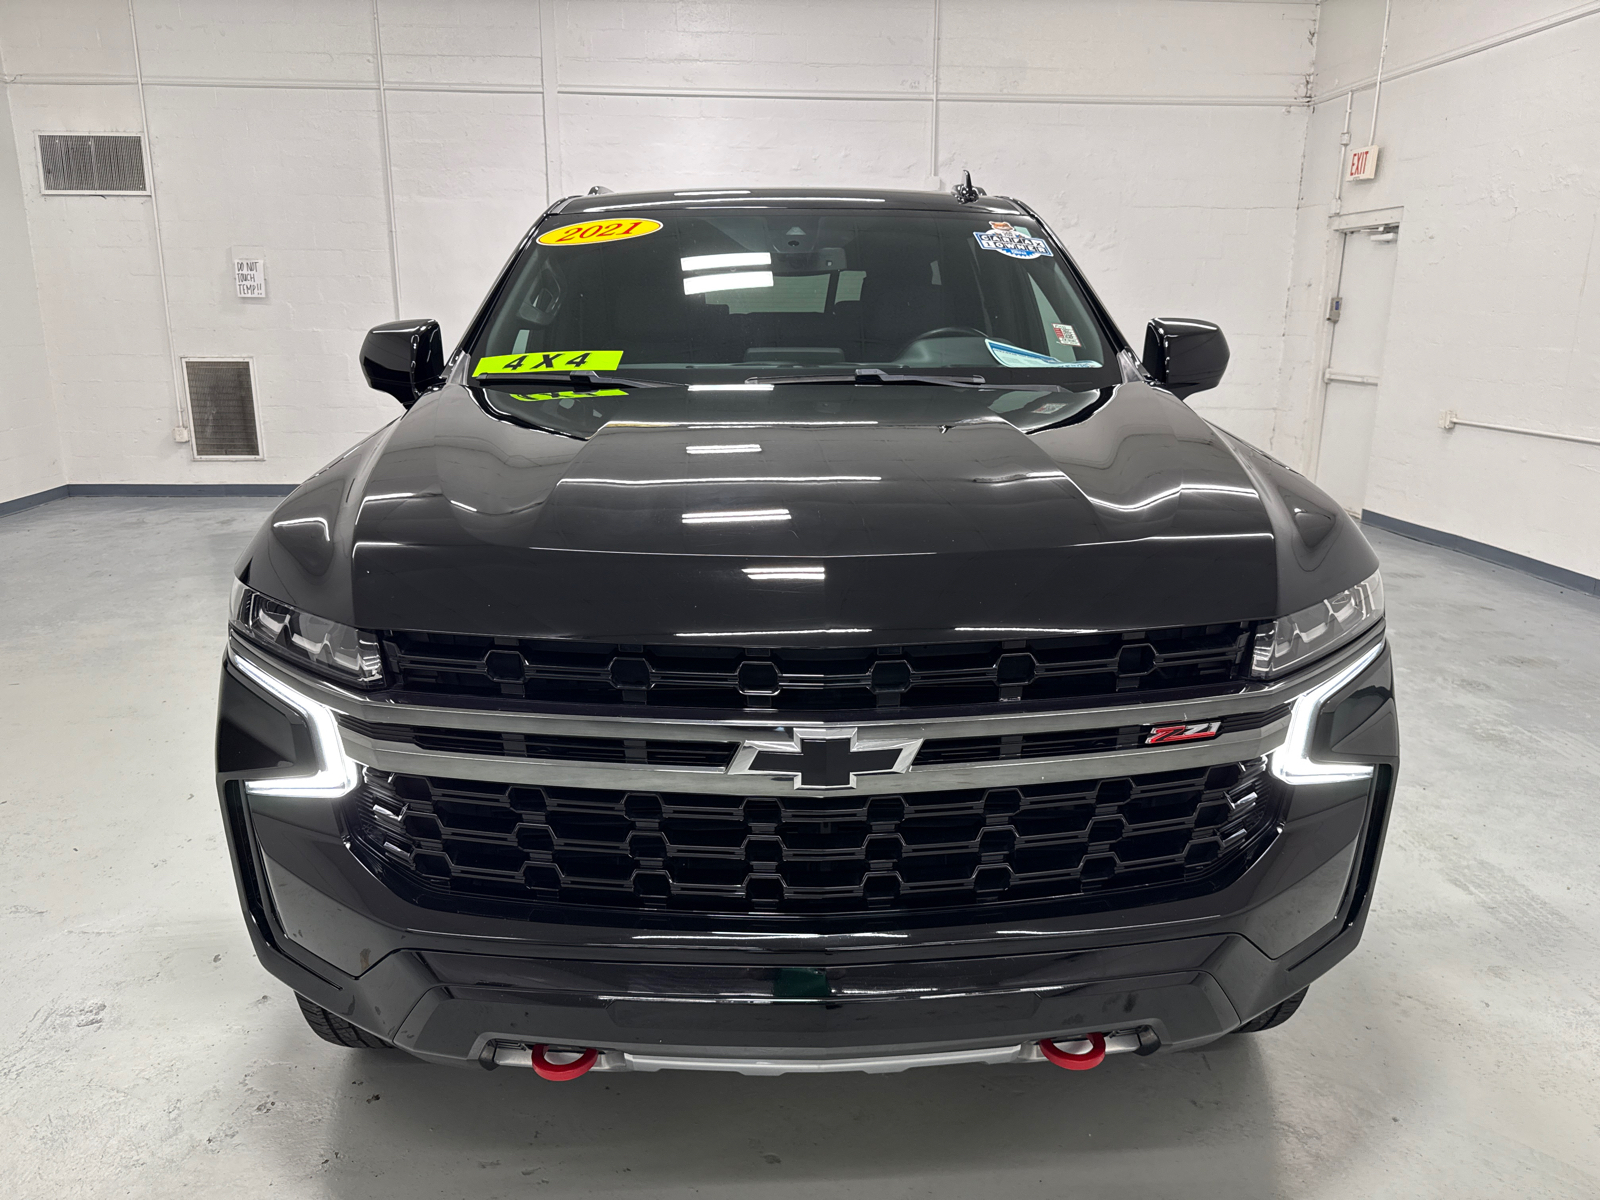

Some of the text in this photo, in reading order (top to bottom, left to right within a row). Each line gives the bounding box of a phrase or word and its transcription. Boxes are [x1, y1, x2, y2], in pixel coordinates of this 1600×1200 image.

[1349, 151, 1369, 176] EXIT
[555, 221, 643, 243] 2021
[980, 234, 1046, 248] CARFAX
[994, 242, 1048, 253] OWNER
[237, 262, 259, 272] DO NOT
[237, 273, 255, 283] TOUCH
[238, 283, 262, 295] TEMP!!
[1145, 721, 1222, 744] Z71
